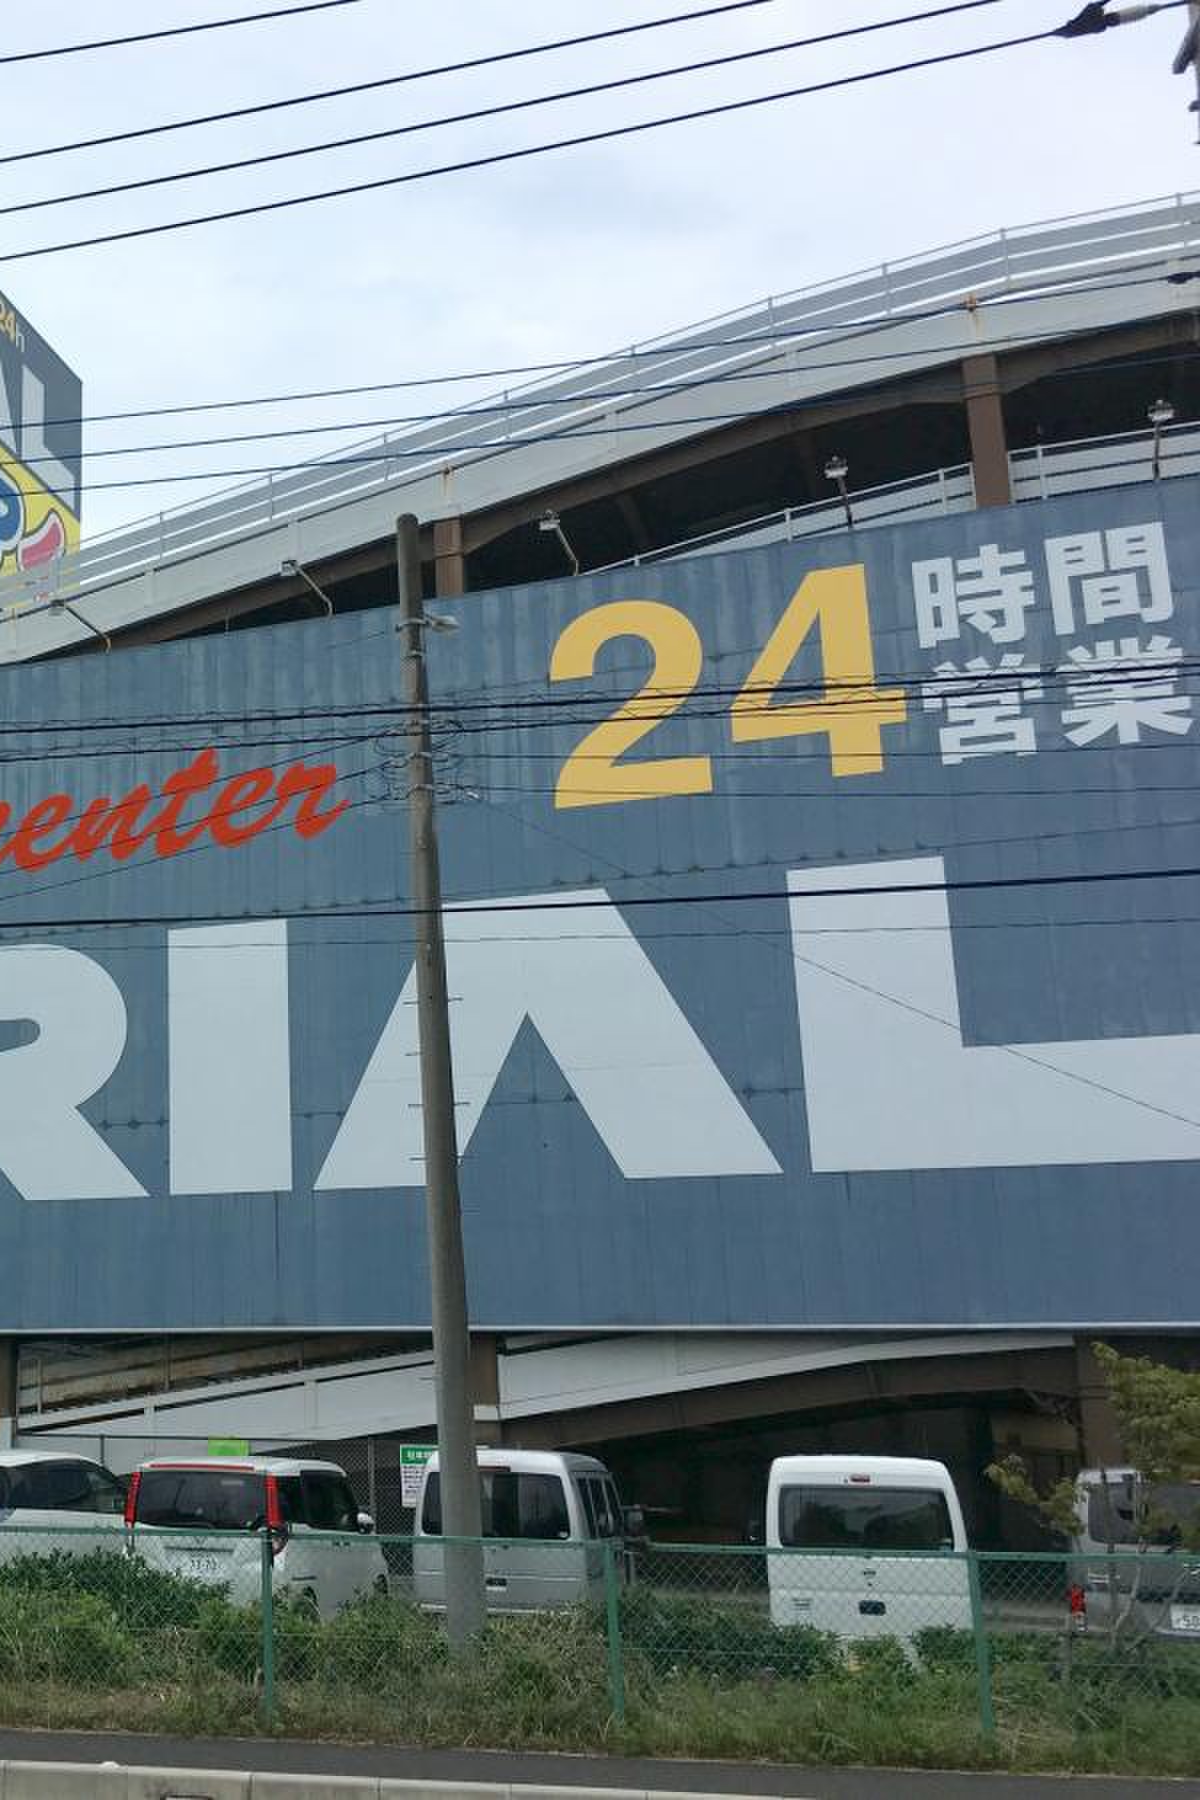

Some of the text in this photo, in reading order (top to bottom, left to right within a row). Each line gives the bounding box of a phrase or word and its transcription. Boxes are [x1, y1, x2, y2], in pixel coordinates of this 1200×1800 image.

[911, 521, 1175, 650] 時間
[549, 563, 908, 810] 24
[921, 634, 1193, 767] 営業
